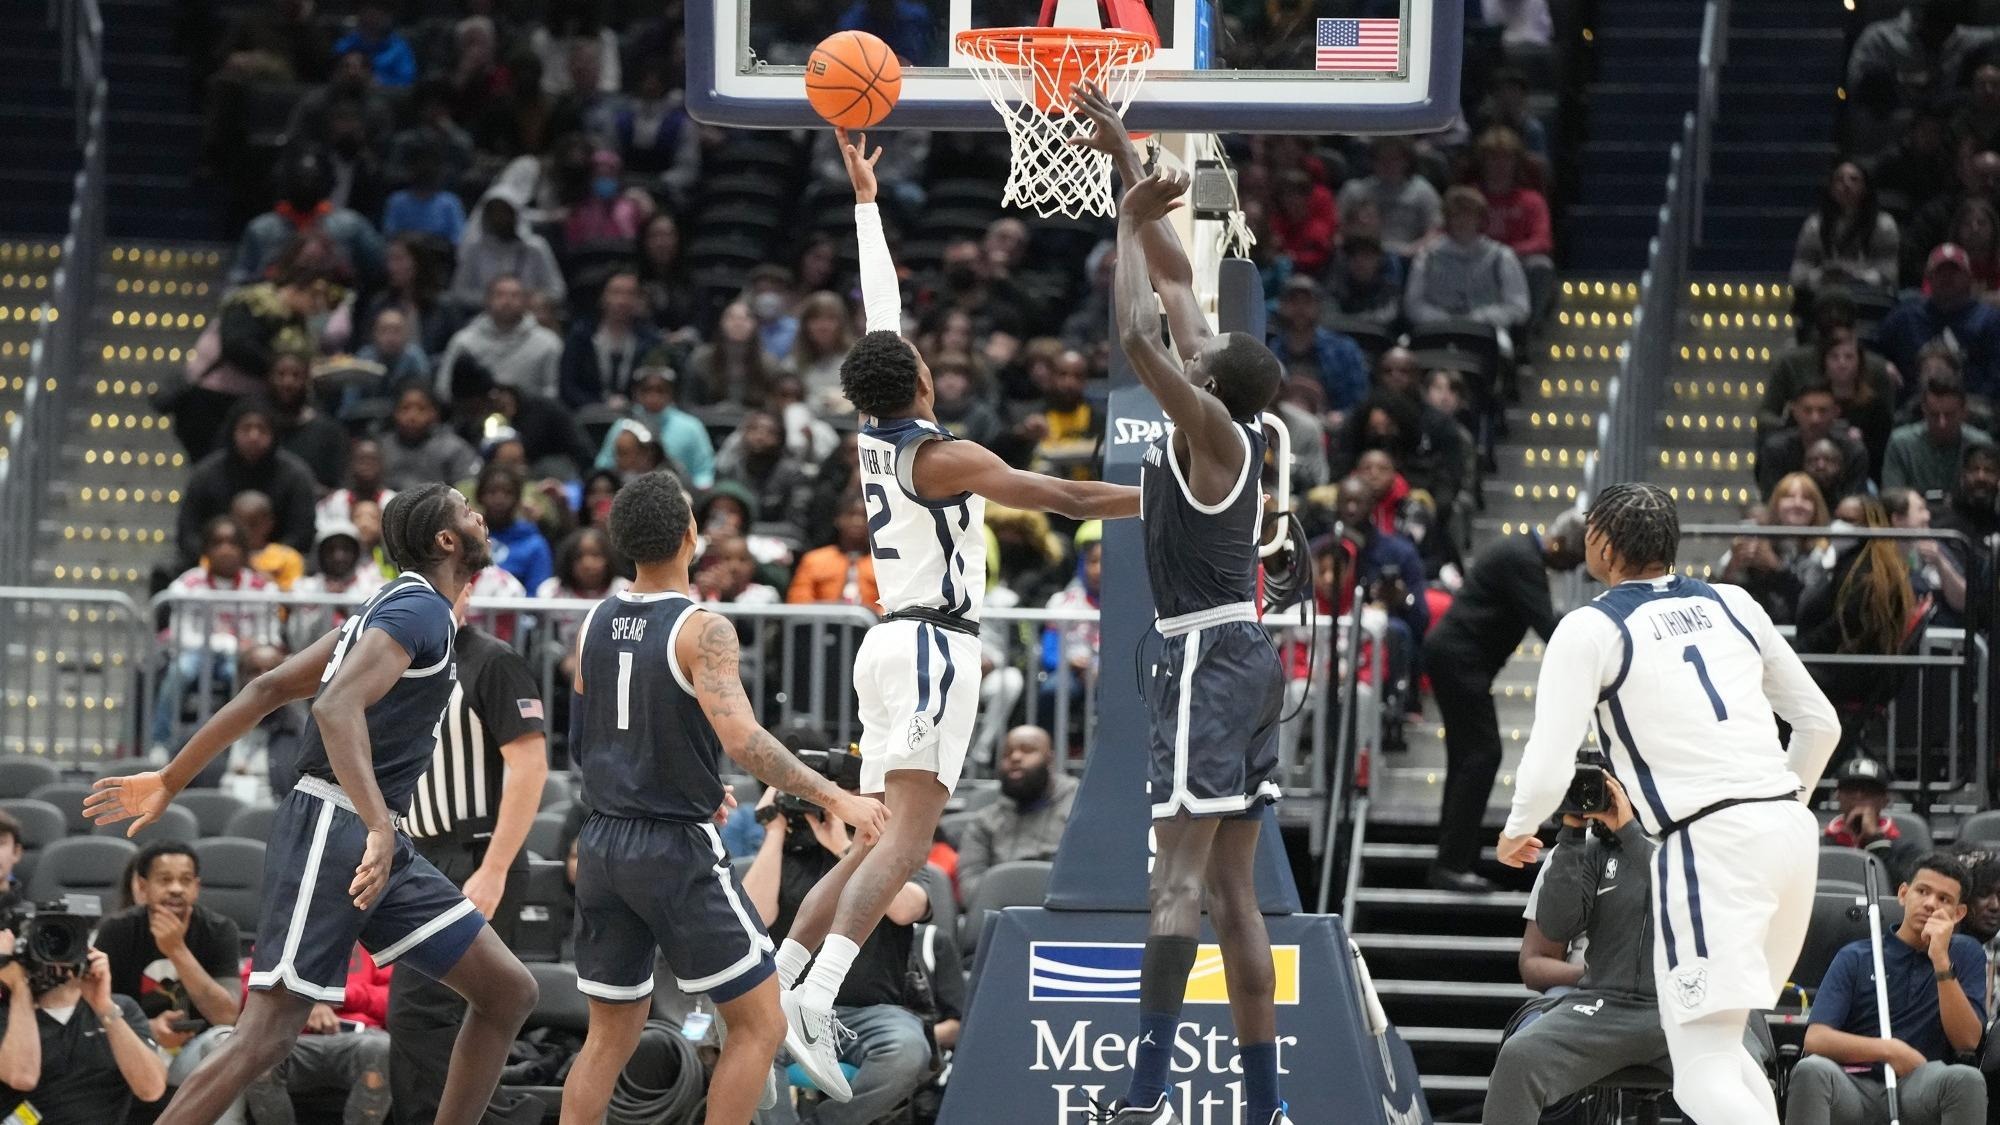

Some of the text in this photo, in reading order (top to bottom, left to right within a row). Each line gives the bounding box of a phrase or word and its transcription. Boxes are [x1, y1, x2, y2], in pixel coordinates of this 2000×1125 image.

[865, 483, 901, 560] 2
[611, 617, 648, 642] SPEARS
[617, 651, 633, 730] 1
[1682, 644, 1728, 722] 1
[1028, 1018, 1298, 1075] MeStar
